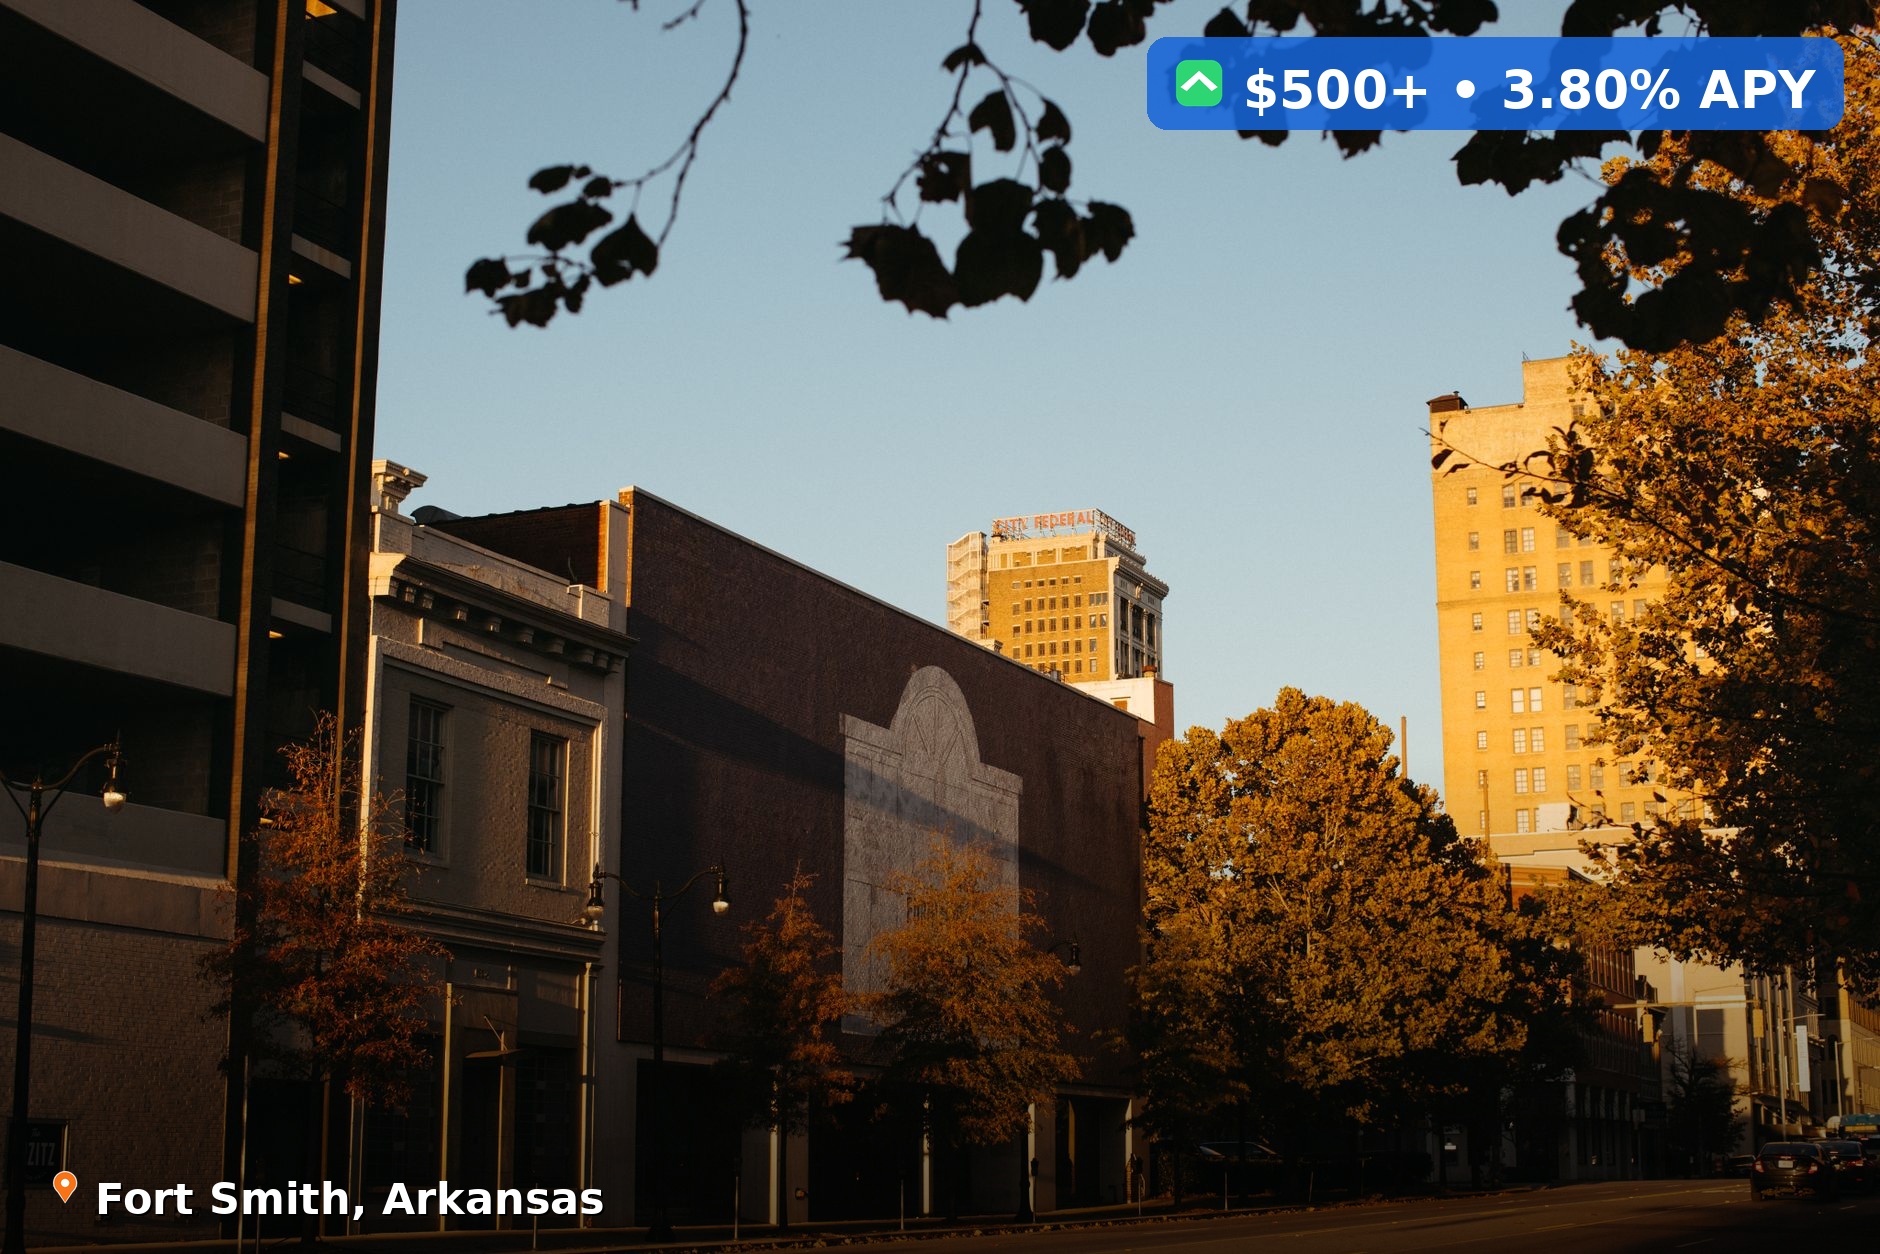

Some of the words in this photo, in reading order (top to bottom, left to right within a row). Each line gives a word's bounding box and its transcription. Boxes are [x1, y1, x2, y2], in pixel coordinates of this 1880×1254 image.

[993, 517, 1028, 533] CITY
[1034, 510, 1094, 529] FEDERAL
[25, 1141, 56, 1167] ZITZ
